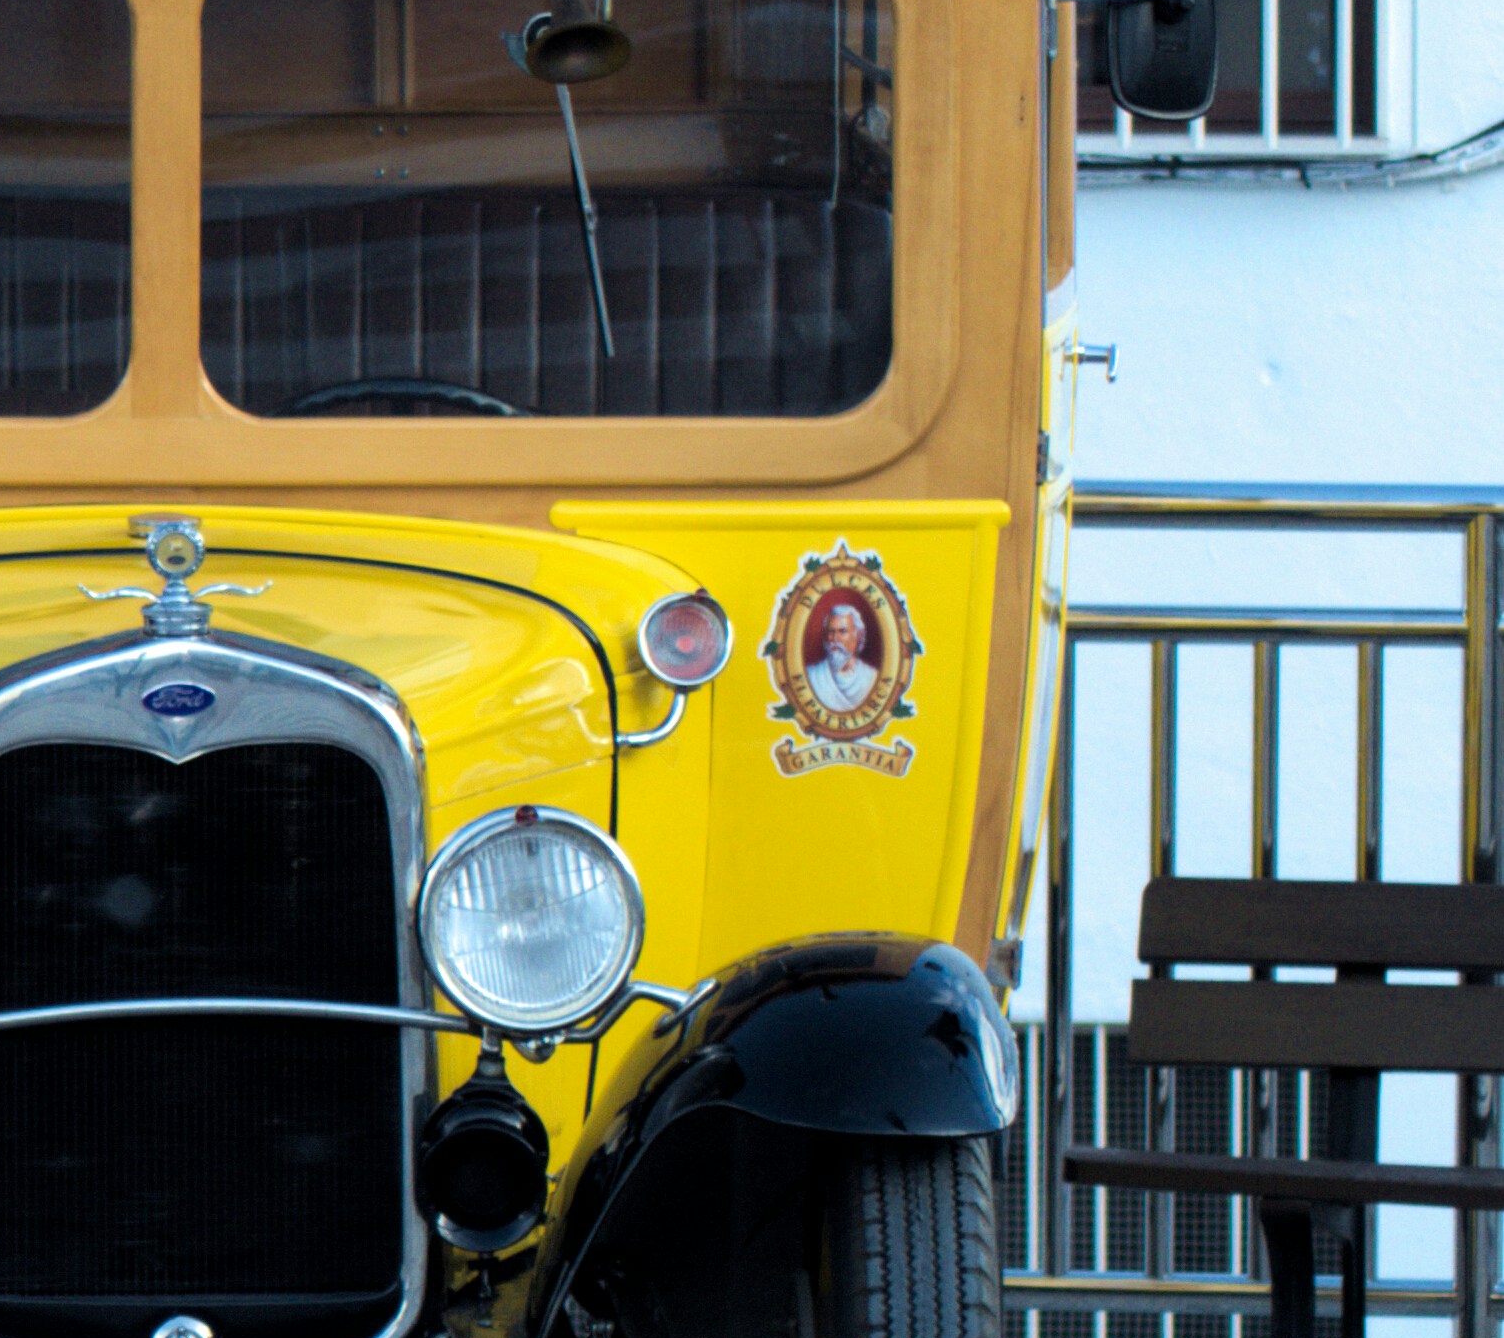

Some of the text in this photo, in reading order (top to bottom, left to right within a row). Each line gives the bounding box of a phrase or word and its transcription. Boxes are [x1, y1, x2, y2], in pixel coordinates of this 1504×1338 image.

[799, 573, 887, 611] DULCES
[151, 688, 206, 711] Ford
[803, 675, 894, 730] PATRIARCA
[791, 743, 897, 770] GARANTIA
